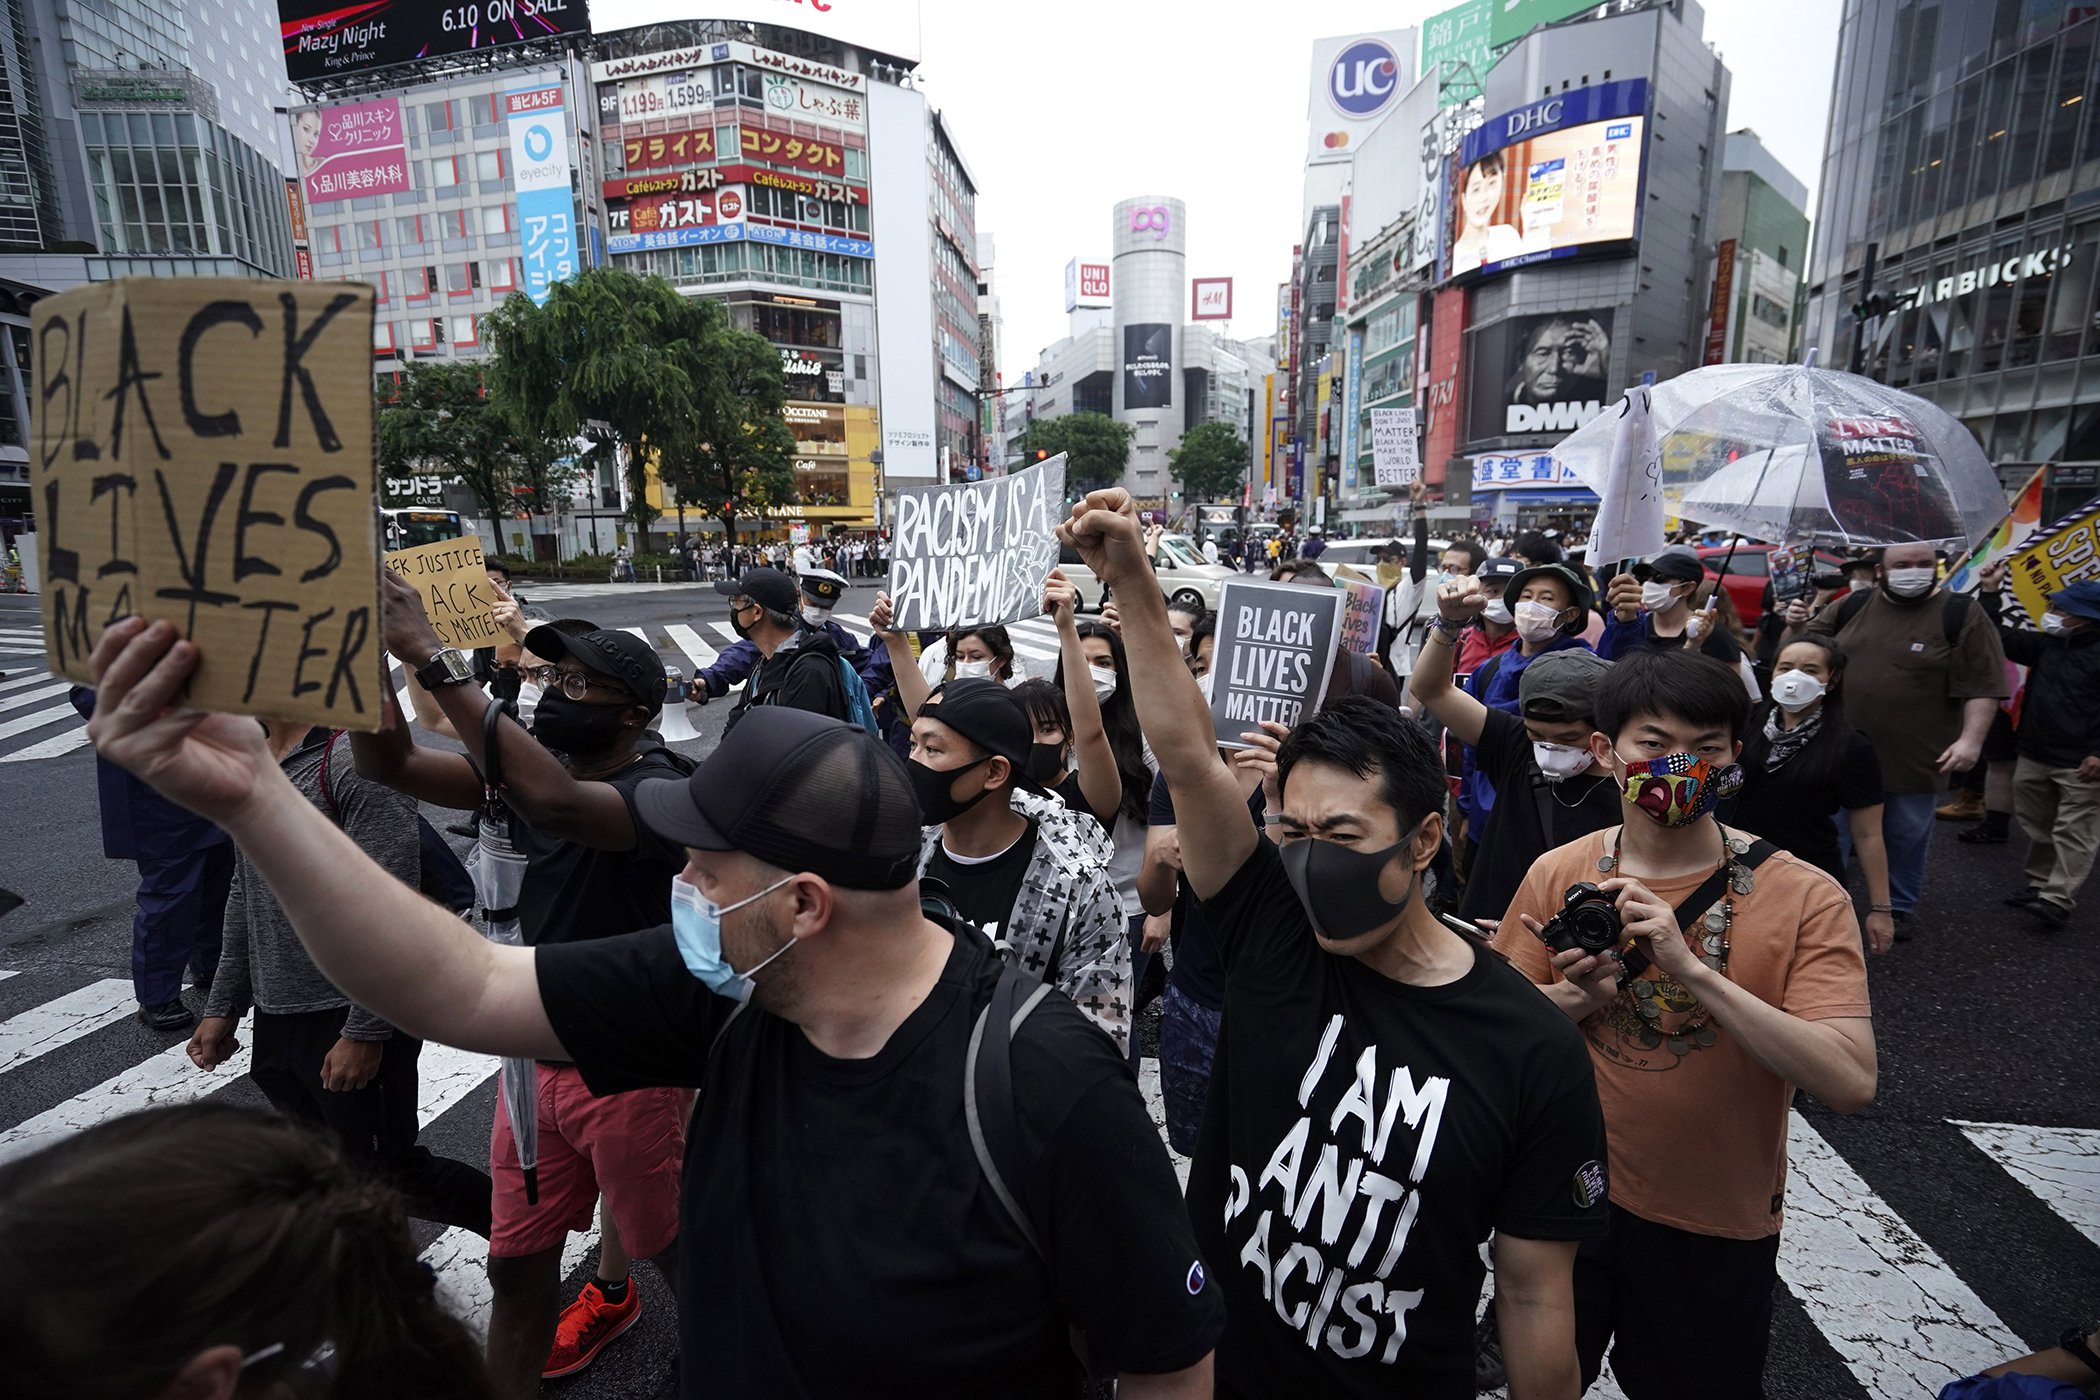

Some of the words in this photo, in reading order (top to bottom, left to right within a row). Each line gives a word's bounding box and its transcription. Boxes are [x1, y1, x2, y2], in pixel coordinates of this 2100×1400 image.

[442, 4, 478, 31] 6.10
[487, 0, 515, 23] ON
[299, 33, 339, 54] Mazy
[342, 21, 386, 47] Night
[324, 54, 343, 68] King
[351, 50, 376, 65] Prince
[511, 91, 557, 111] 当ビル5F
[600, 95, 618, 112] 9F
[799, 87, 860, 120] しゃぶ葉
[341, 107, 395, 130] 品川スキン
[1506, 101, 1564, 138] DHC
[1608, 126, 1630, 138] DHC
[344, 125, 391, 145] クリニック
[626, 132, 713, 164] プライス
[741, 129, 840, 168] コンタクト
[320, 163, 403, 194] 品川美容外科
[520, 165, 563, 182] eyecity
[681, 168, 724, 192] ガスト
[814, 181, 859, 205] ガスト
[609, 210, 630, 228] 7F
[659, 198, 712, 229] ガスト
[552, 213, 573, 288] コンタ
[644, 228, 721, 248] 英会話イーオン
[752, 225, 783, 240] AEON
[789, 231, 872, 254] 英会話イーオン
[525, 215, 553, 310] アイシ
[1083, 267, 1106, 280] UNI
[1083, 281, 1107, 296] QLO
[1889, 243, 2073, 315] TARBUCKS
[39, 292, 360, 470] BLACK
[1506, 400, 1602, 432] DMM
[1374, 427, 1415, 437] MATTER
[1384, 456, 1411, 465] WORLD
[1842, 437, 1916, 456] MATTER
[796, 460, 816, 471] Café
[1378, 468, 1418, 483] BETTER
[45, 463, 357, 584] LIVES
[896, 484, 997, 559] RACISM
[1005, 476, 1026, 549] IS
[1027, 466, 1048, 536] A
[416, 548, 484, 575] JUSTICE
[887, 548, 1017, 630] PANDEMIC
[2030, 568, 2046, 584] NO
[426, 583, 490, 617] ACK
[1345, 592, 1379, 616] Black
[1236, 606, 1316, 646] BLACK
[1342, 613, 1369, 634] ives
[54, 583, 370, 714] MATTER
[1340, 631, 1371, 654] atter
[1229, 645, 1312, 693] LIVES
[1225, 692, 1303, 728] MATTER
[1568, 889, 1582, 902] SONY
[1299, 1014, 1345, 1110] I
[1330, 1045, 1451, 1183] AM
[1259, 1117, 1421, 1280] ANTI
